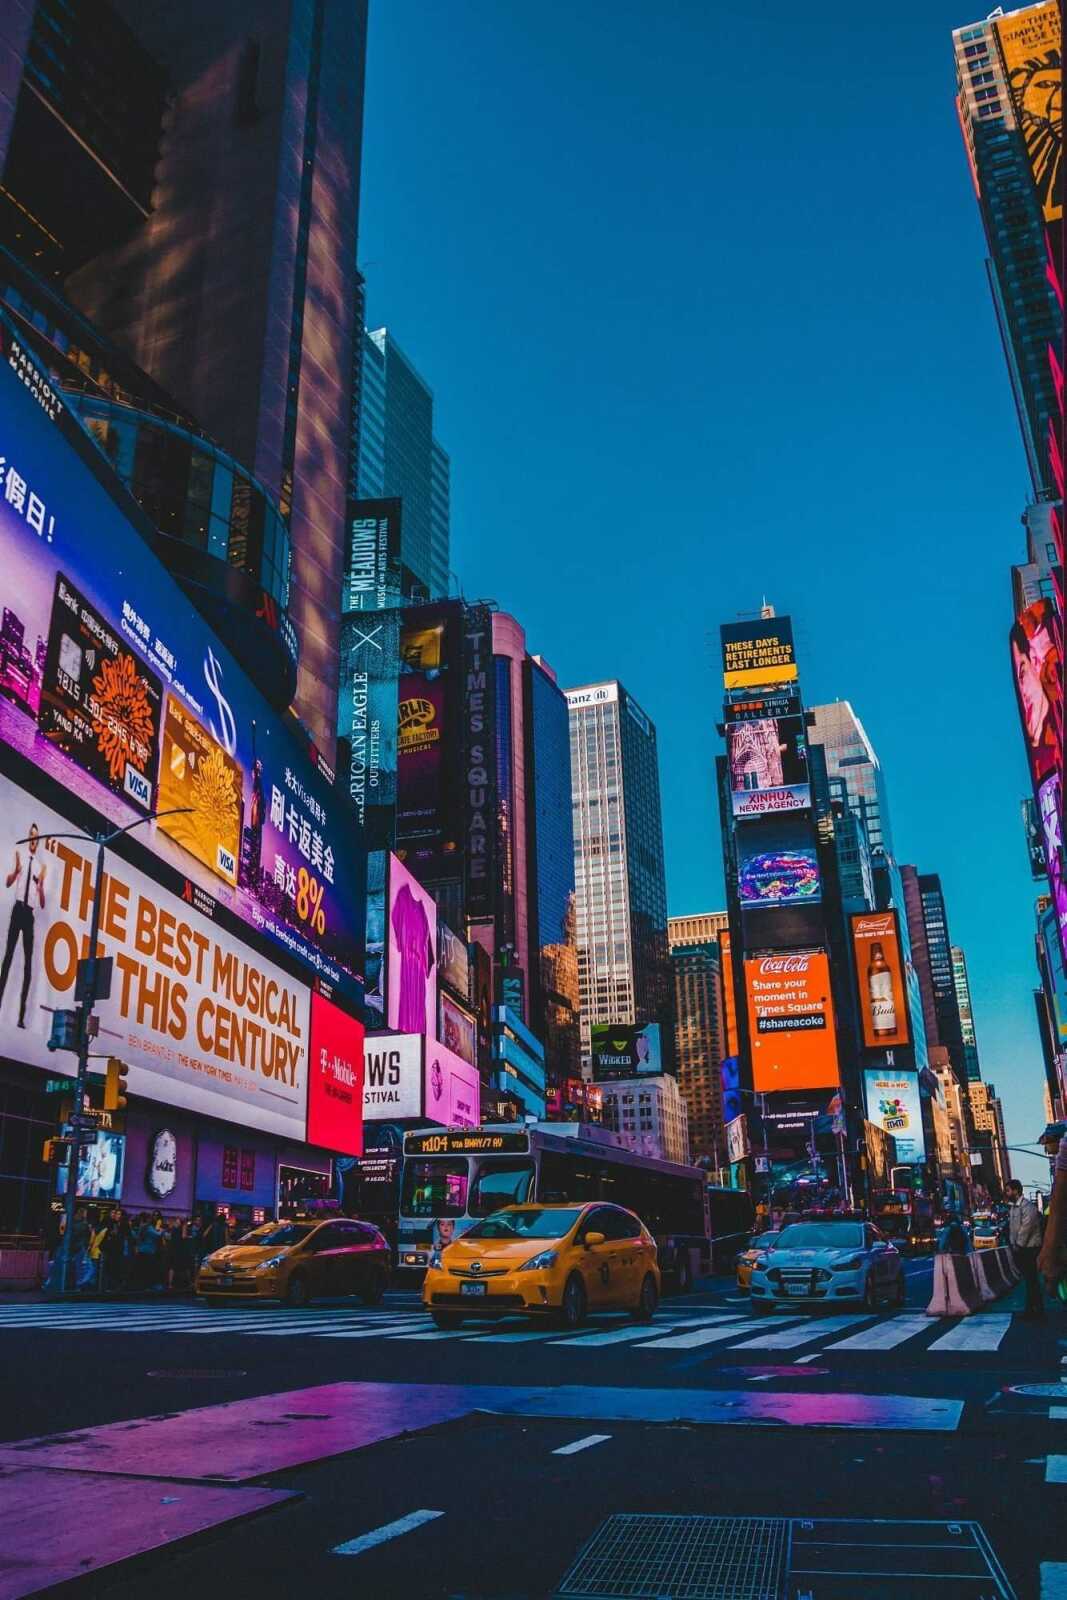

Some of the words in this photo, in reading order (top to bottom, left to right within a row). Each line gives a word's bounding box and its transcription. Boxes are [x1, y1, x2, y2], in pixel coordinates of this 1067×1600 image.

[377, 516, 389, 546] FESTIVAL
[351, 518, 377, 592] MEADOWS
[377, 548, 388, 570] ARTS
[350, 594, 359, 610] THE
[377, 586, 386, 609] MUSIC
[725, 640, 753, 652] THESE
[756, 637, 779, 648] DAYS
[725, 645, 792, 661] RETIREMENTS
[726, 659, 751, 670] LAST
[753, 654, 790, 667] LONGER
[57, 668, 80, 702] 4815
[466, 632, 487, 732] TIMES
[351, 672, 368, 734] EAGLE
[735, 706, 790, 720] GALLERY
[369, 719, 380, 788] OUTFITTERS
[128, 770, 148, 802] VISA
[739, 802, 765, 813] NEWS
[768, 798, 805, 811] AGENCY
[748, 791, 794, 804] XINHUA
[467, 745, 488, 878] SQUARE
[270, 784, 336, 884] 刷卡返美金
[219, 849, 234, 874] VISA
[135, 896, 209, 984] BEST
[212, 946, 300, 1038] MUSICAL
[752, 980, 781, 990] Share
[784, 980, 807, 990] your
[116, 953, 187, 1041] THIS
[754, 992, 797, 1002] moment
[799, 991, 808, 999] in
[755, 1005, 785, 1015] Times
[788, 1002, 823, 1013] Square
[759, 1016, 824, 1029] #shareacoke
[421, 1136, 448, 1152] M104
[451, 1140, 463, 1148] VIA
